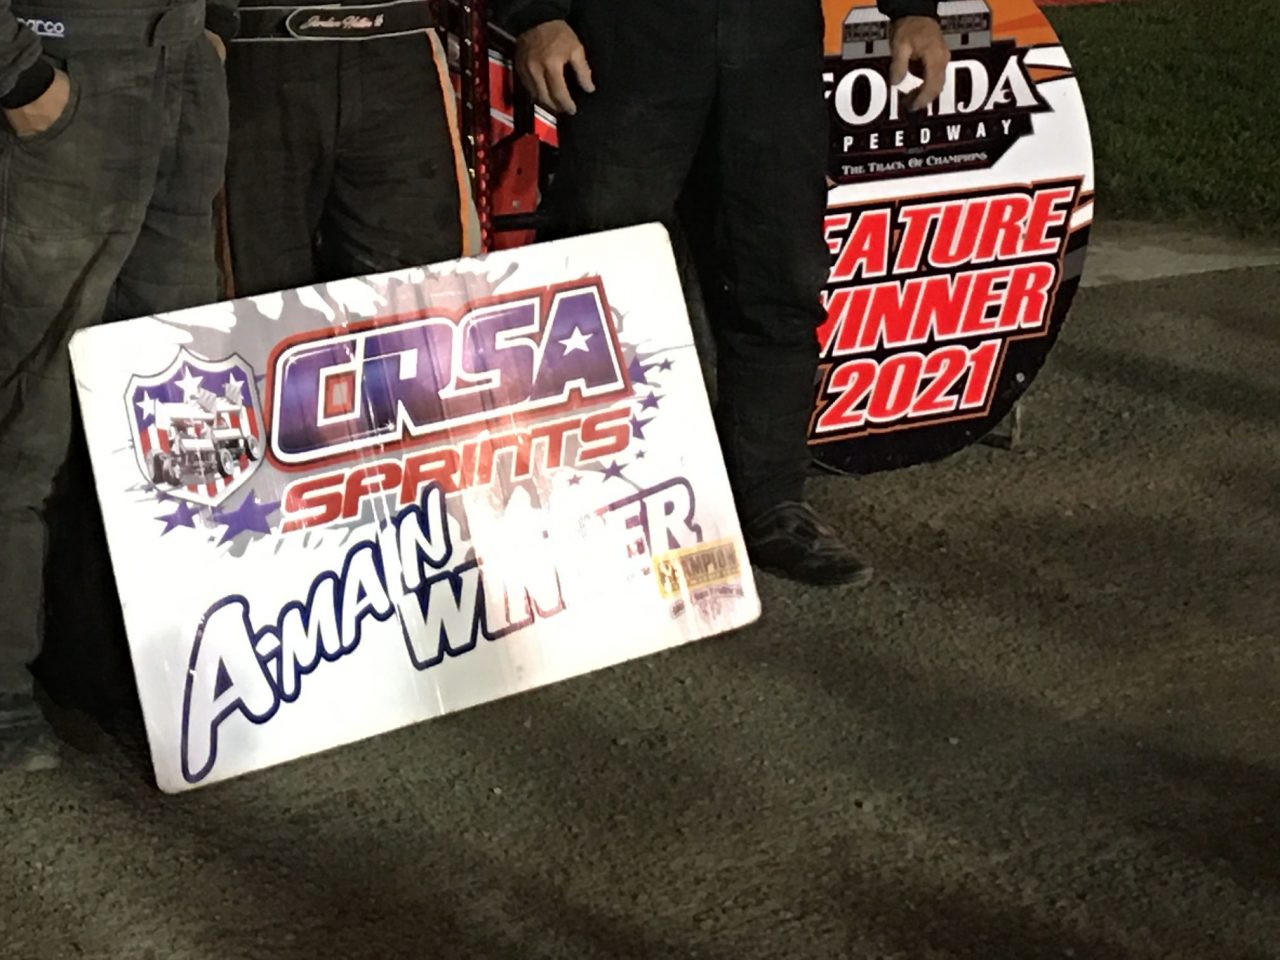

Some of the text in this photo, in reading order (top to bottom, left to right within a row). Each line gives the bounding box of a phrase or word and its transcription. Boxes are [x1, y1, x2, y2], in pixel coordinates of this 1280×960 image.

[841, 164, 866, 176] THE
[867, 161, 906, 173] TRACK
[842, 118, 1012, 152] PEEDWAY
[824, 186, 1075, 283] EATURE
[270, 280, 630, 465] CRSA
[815, 338, 1003, 433] 2021
[281, 406, 639, 534] SPRINTS
